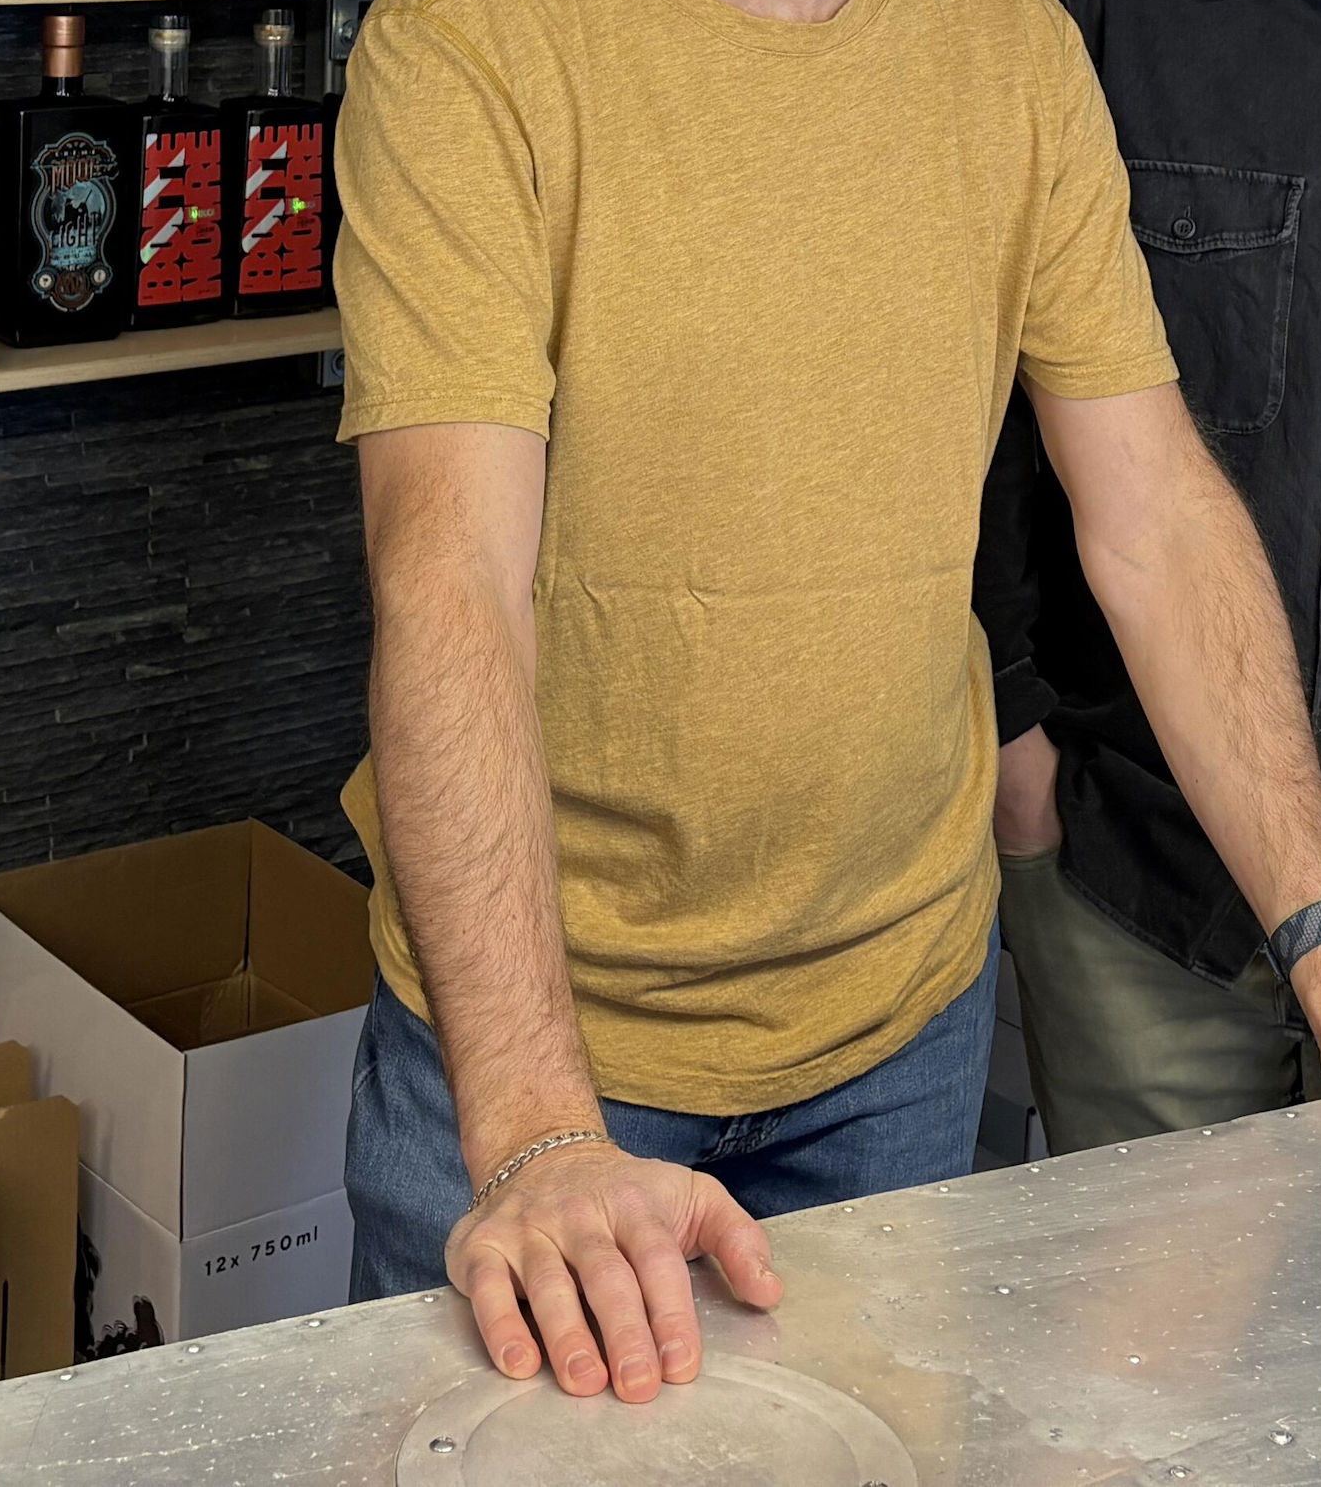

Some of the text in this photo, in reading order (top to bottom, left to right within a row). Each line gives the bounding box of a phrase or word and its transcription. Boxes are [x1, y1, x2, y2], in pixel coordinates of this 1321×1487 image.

[49, 213, 98, 249] LIGHT
[205, 1225, 318, 1276] 12x 750ml
